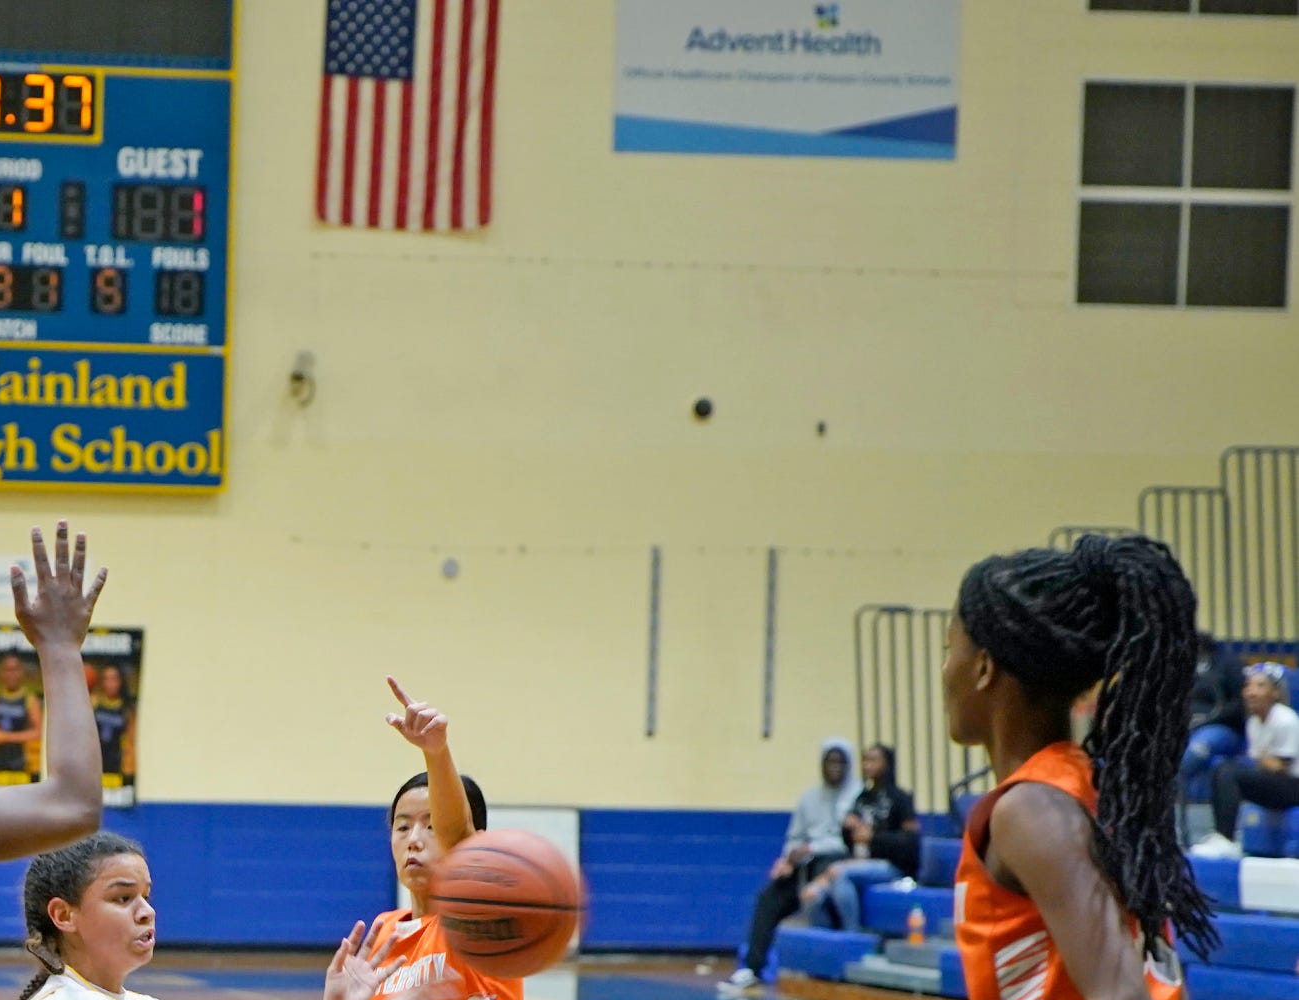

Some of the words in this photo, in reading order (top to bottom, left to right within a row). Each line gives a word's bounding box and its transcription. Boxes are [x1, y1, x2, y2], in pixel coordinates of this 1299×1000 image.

[116, 146, 204, 178] GUEST
[152, 246, 210, 271] FOULS
[149, 322, 209, 345] SCORE
[51, 422, 223, 476] School
